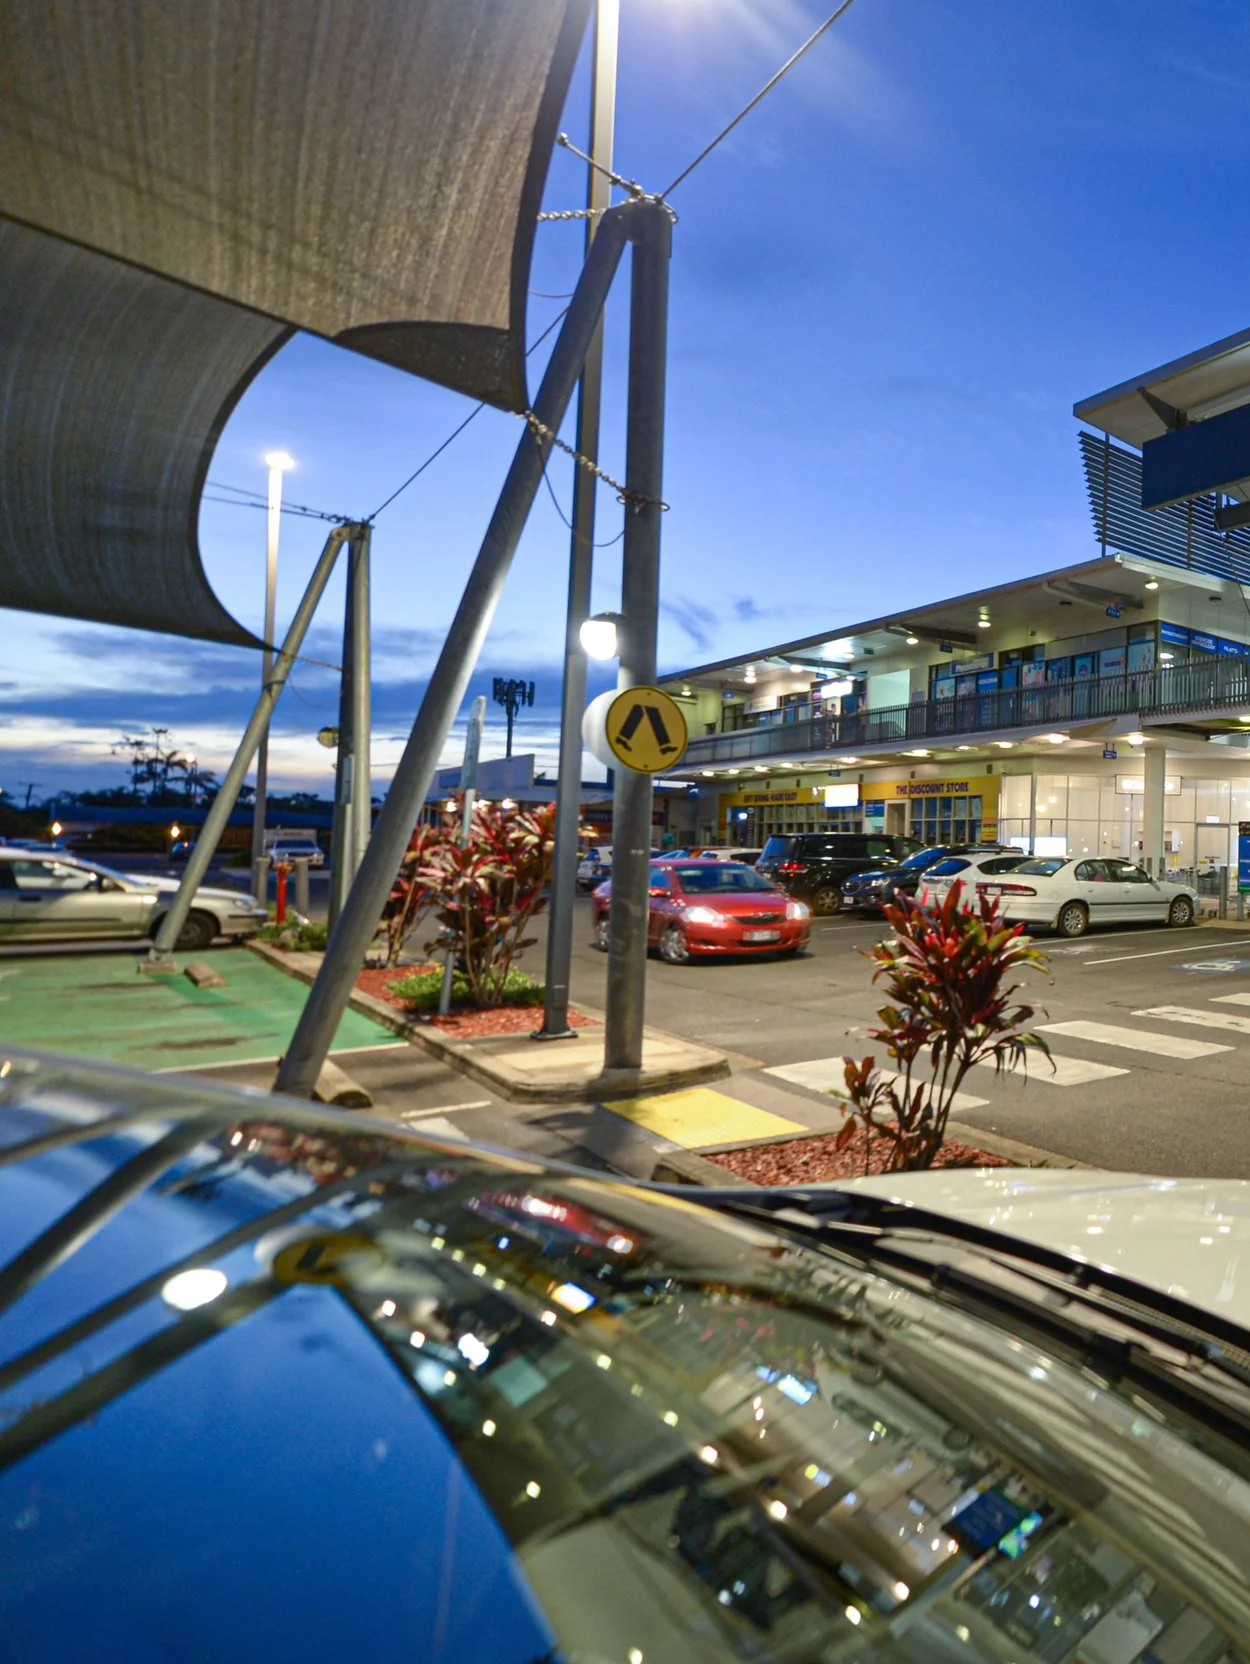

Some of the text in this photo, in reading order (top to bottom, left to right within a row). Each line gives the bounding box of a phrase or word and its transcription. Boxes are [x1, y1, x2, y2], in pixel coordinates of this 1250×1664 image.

[896, 781, 969, 795] THE DISCOUNT STORE
